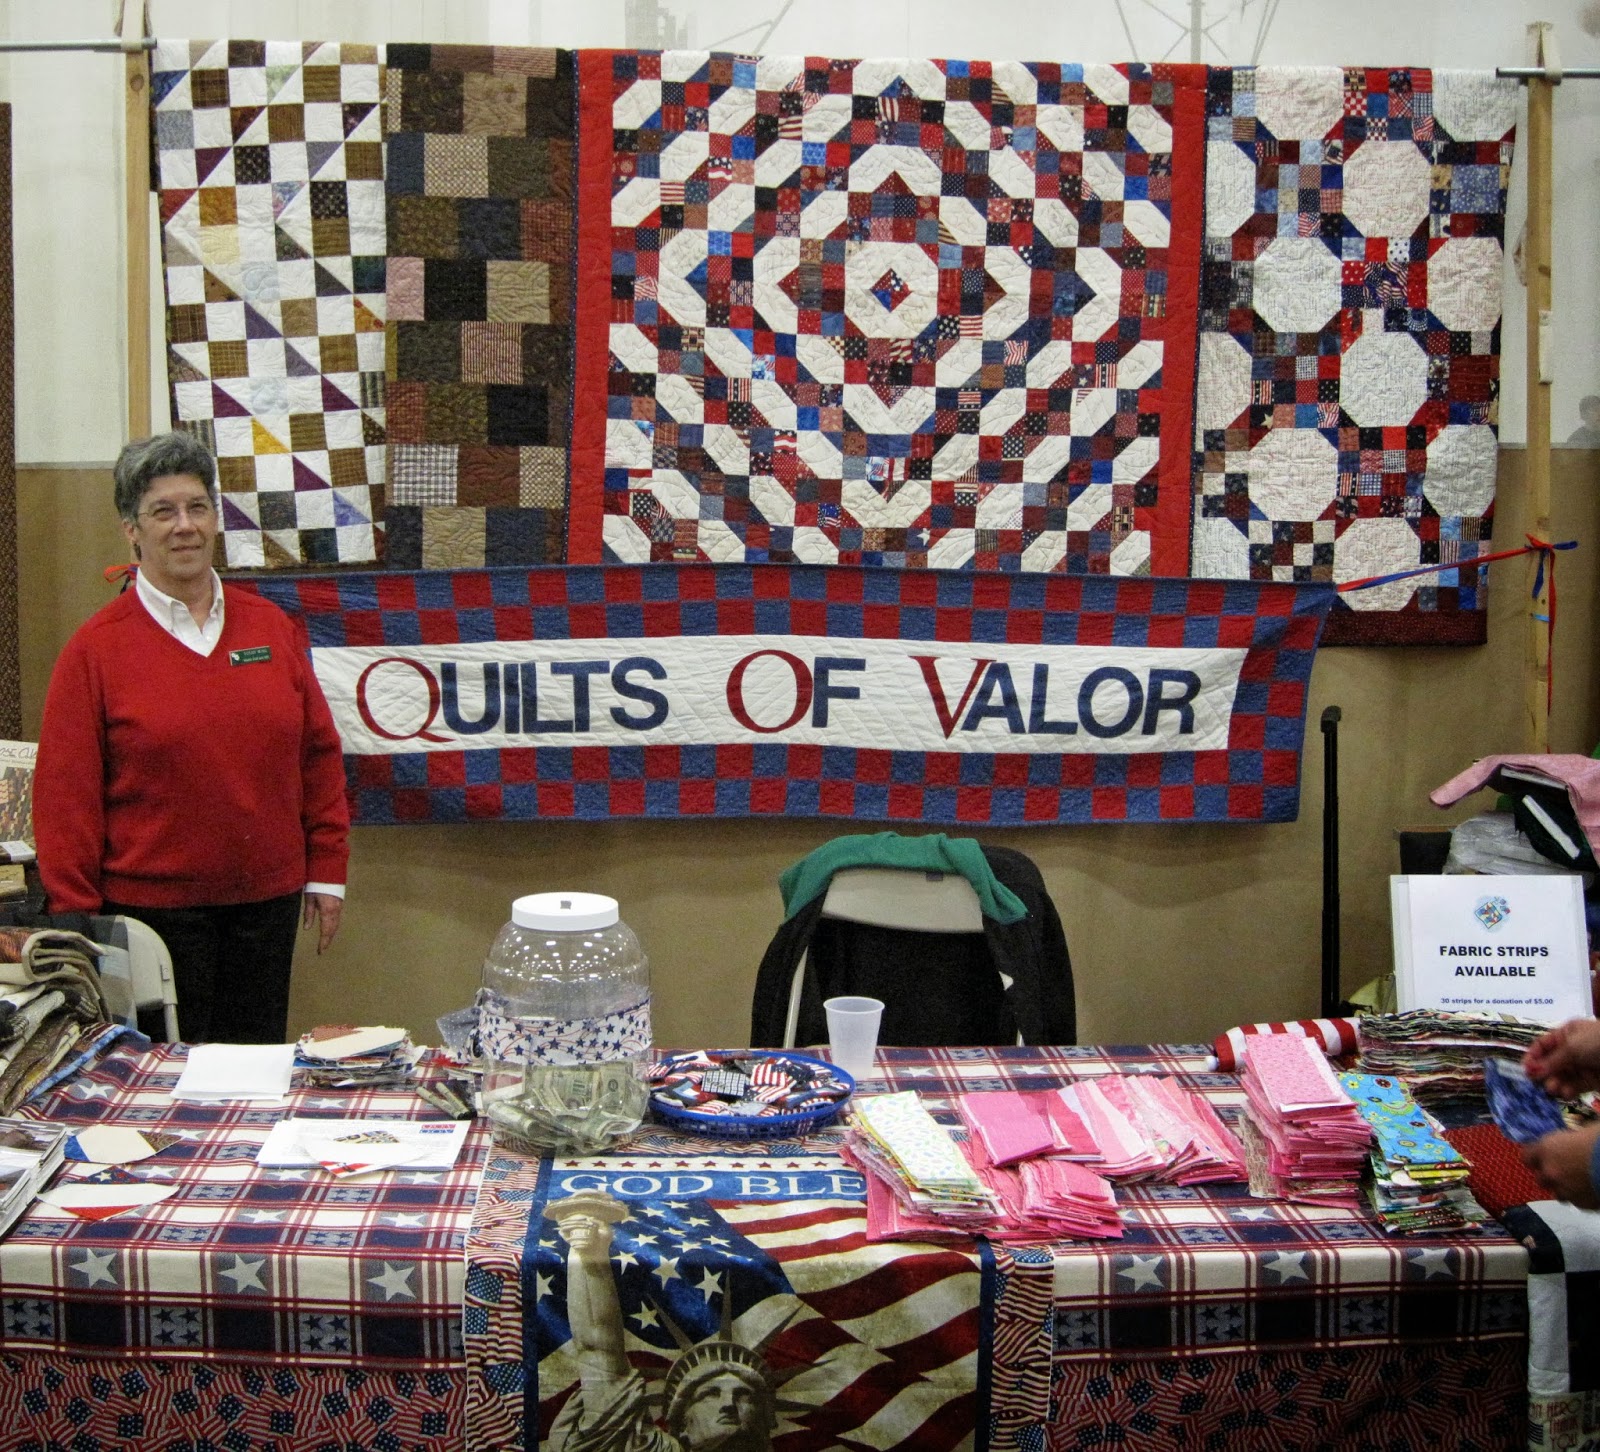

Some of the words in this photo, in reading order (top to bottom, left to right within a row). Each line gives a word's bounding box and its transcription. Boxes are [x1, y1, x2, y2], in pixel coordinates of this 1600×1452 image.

[356, 656, 669, 742] QUILTS
[726, 649, 867, 734] OF
[908, 655, 1202, 740] VALOR
[1439, 945, 1492, 957] FABRIC
[1496, 945, 1549, 957] STRIPS
[1454, 965, 1536, 977] AVAILABLE
[1452, 997, 1472, 1005] strips
[560, 1174, 714, 1197] GOD
